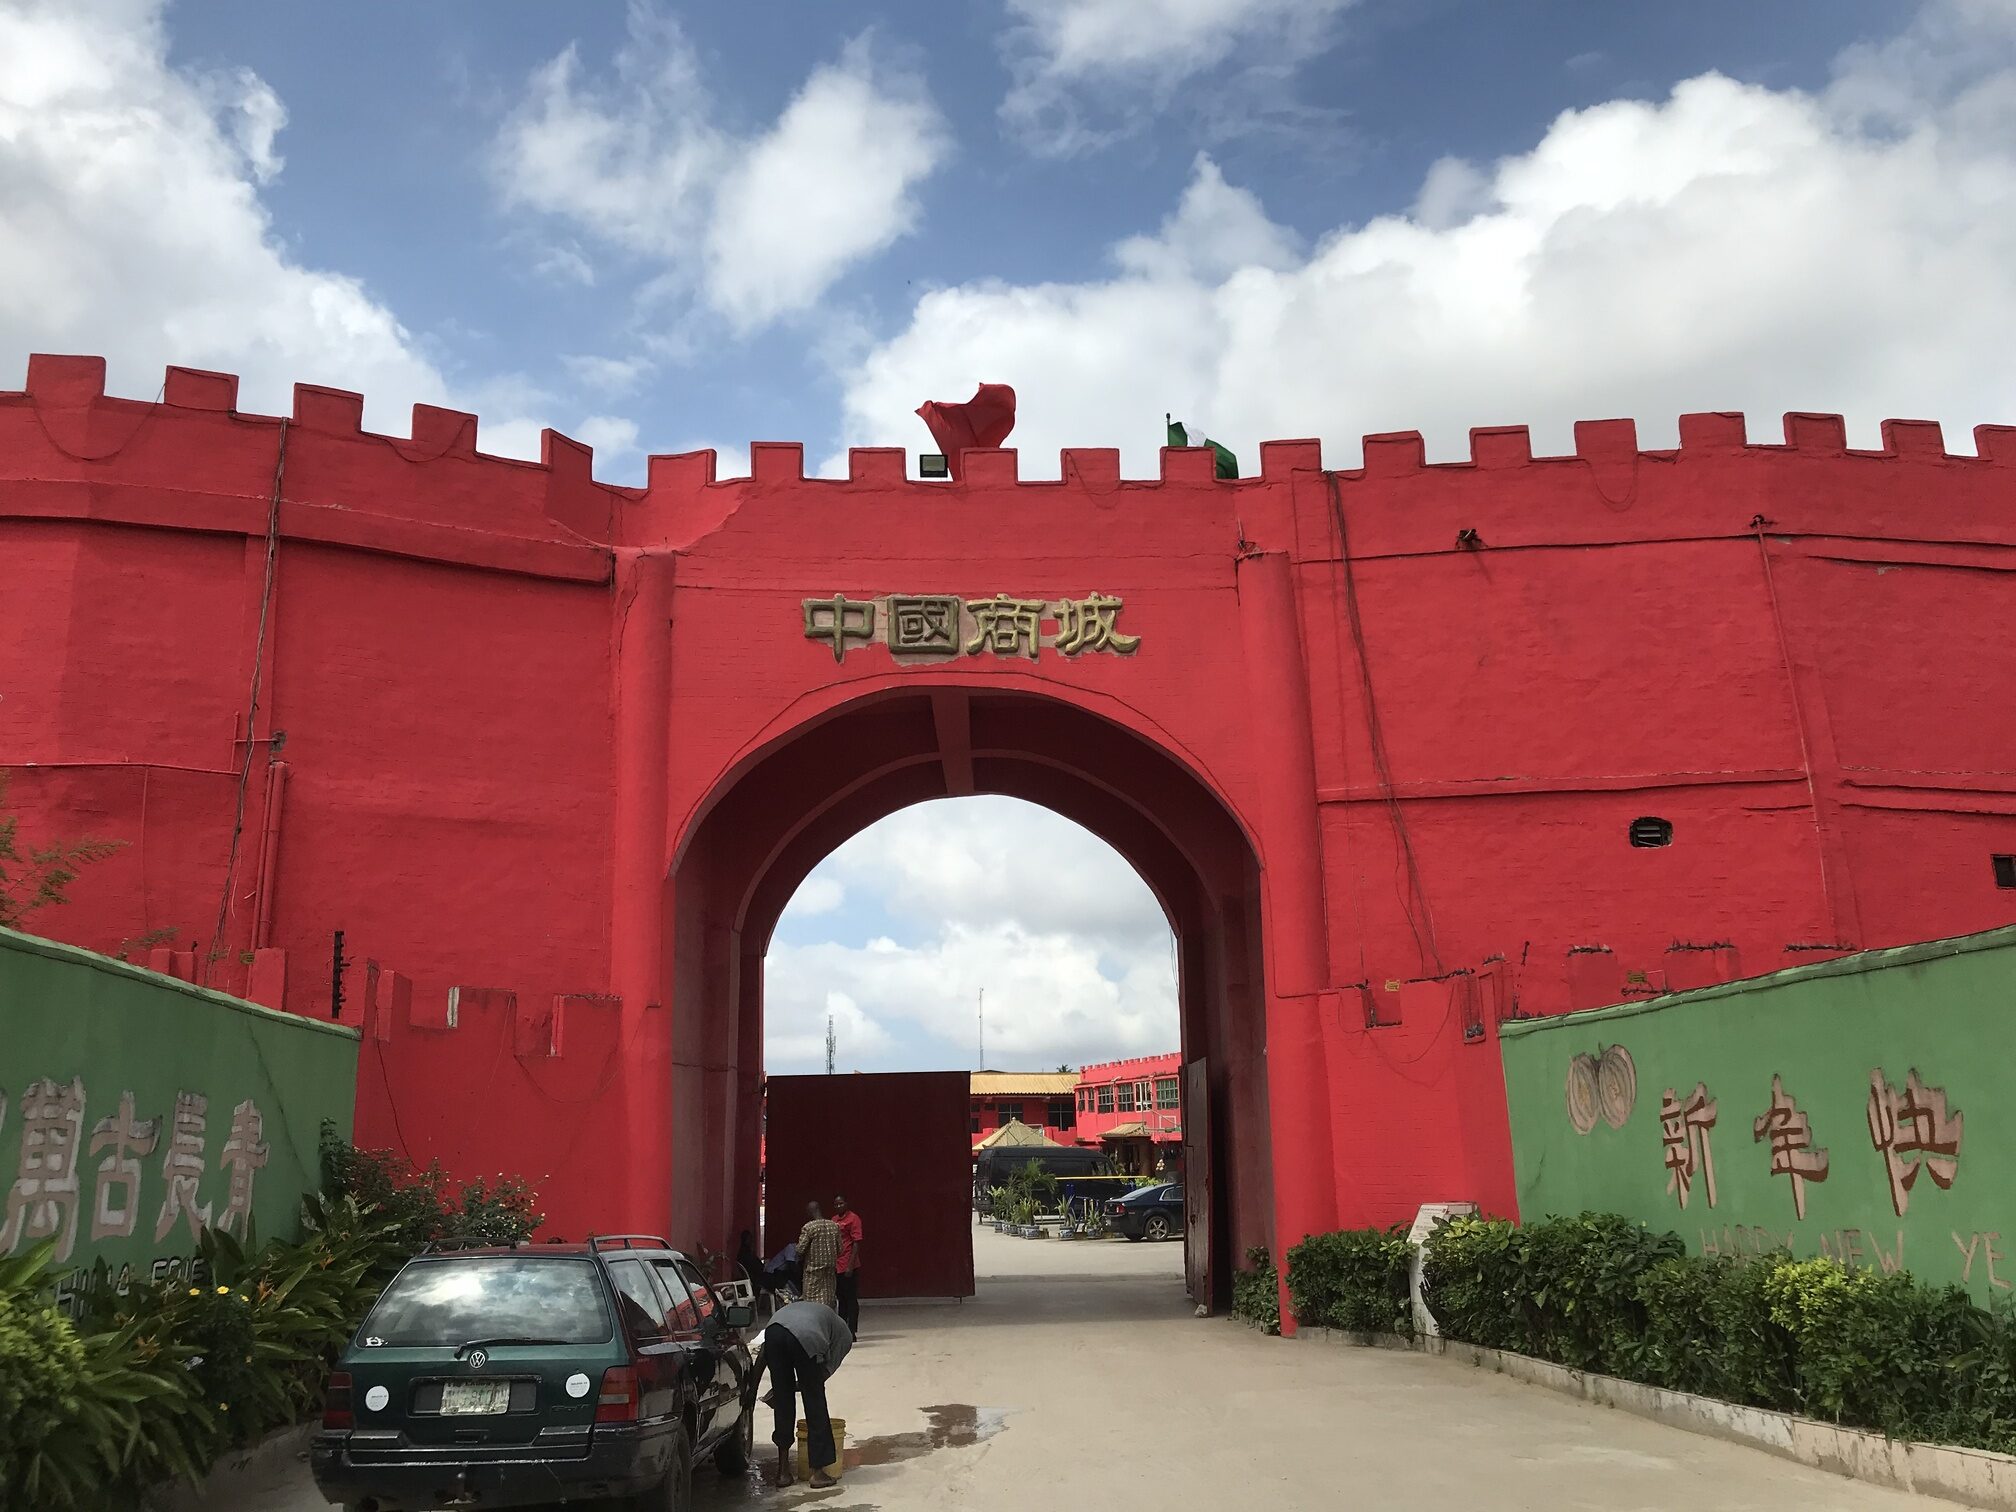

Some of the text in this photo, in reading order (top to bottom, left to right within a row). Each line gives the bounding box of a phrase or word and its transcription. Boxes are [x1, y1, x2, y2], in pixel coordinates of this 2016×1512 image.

[802, 592, 1141, 665] 中國商城
[0, 1075, 271, 1264] 萬古長青
[1659, 1067, 1964, 1221] 新年快
[1820, 1229, 1904, 1274] NEW
[1951, 1231, 2012, 1290] YE
